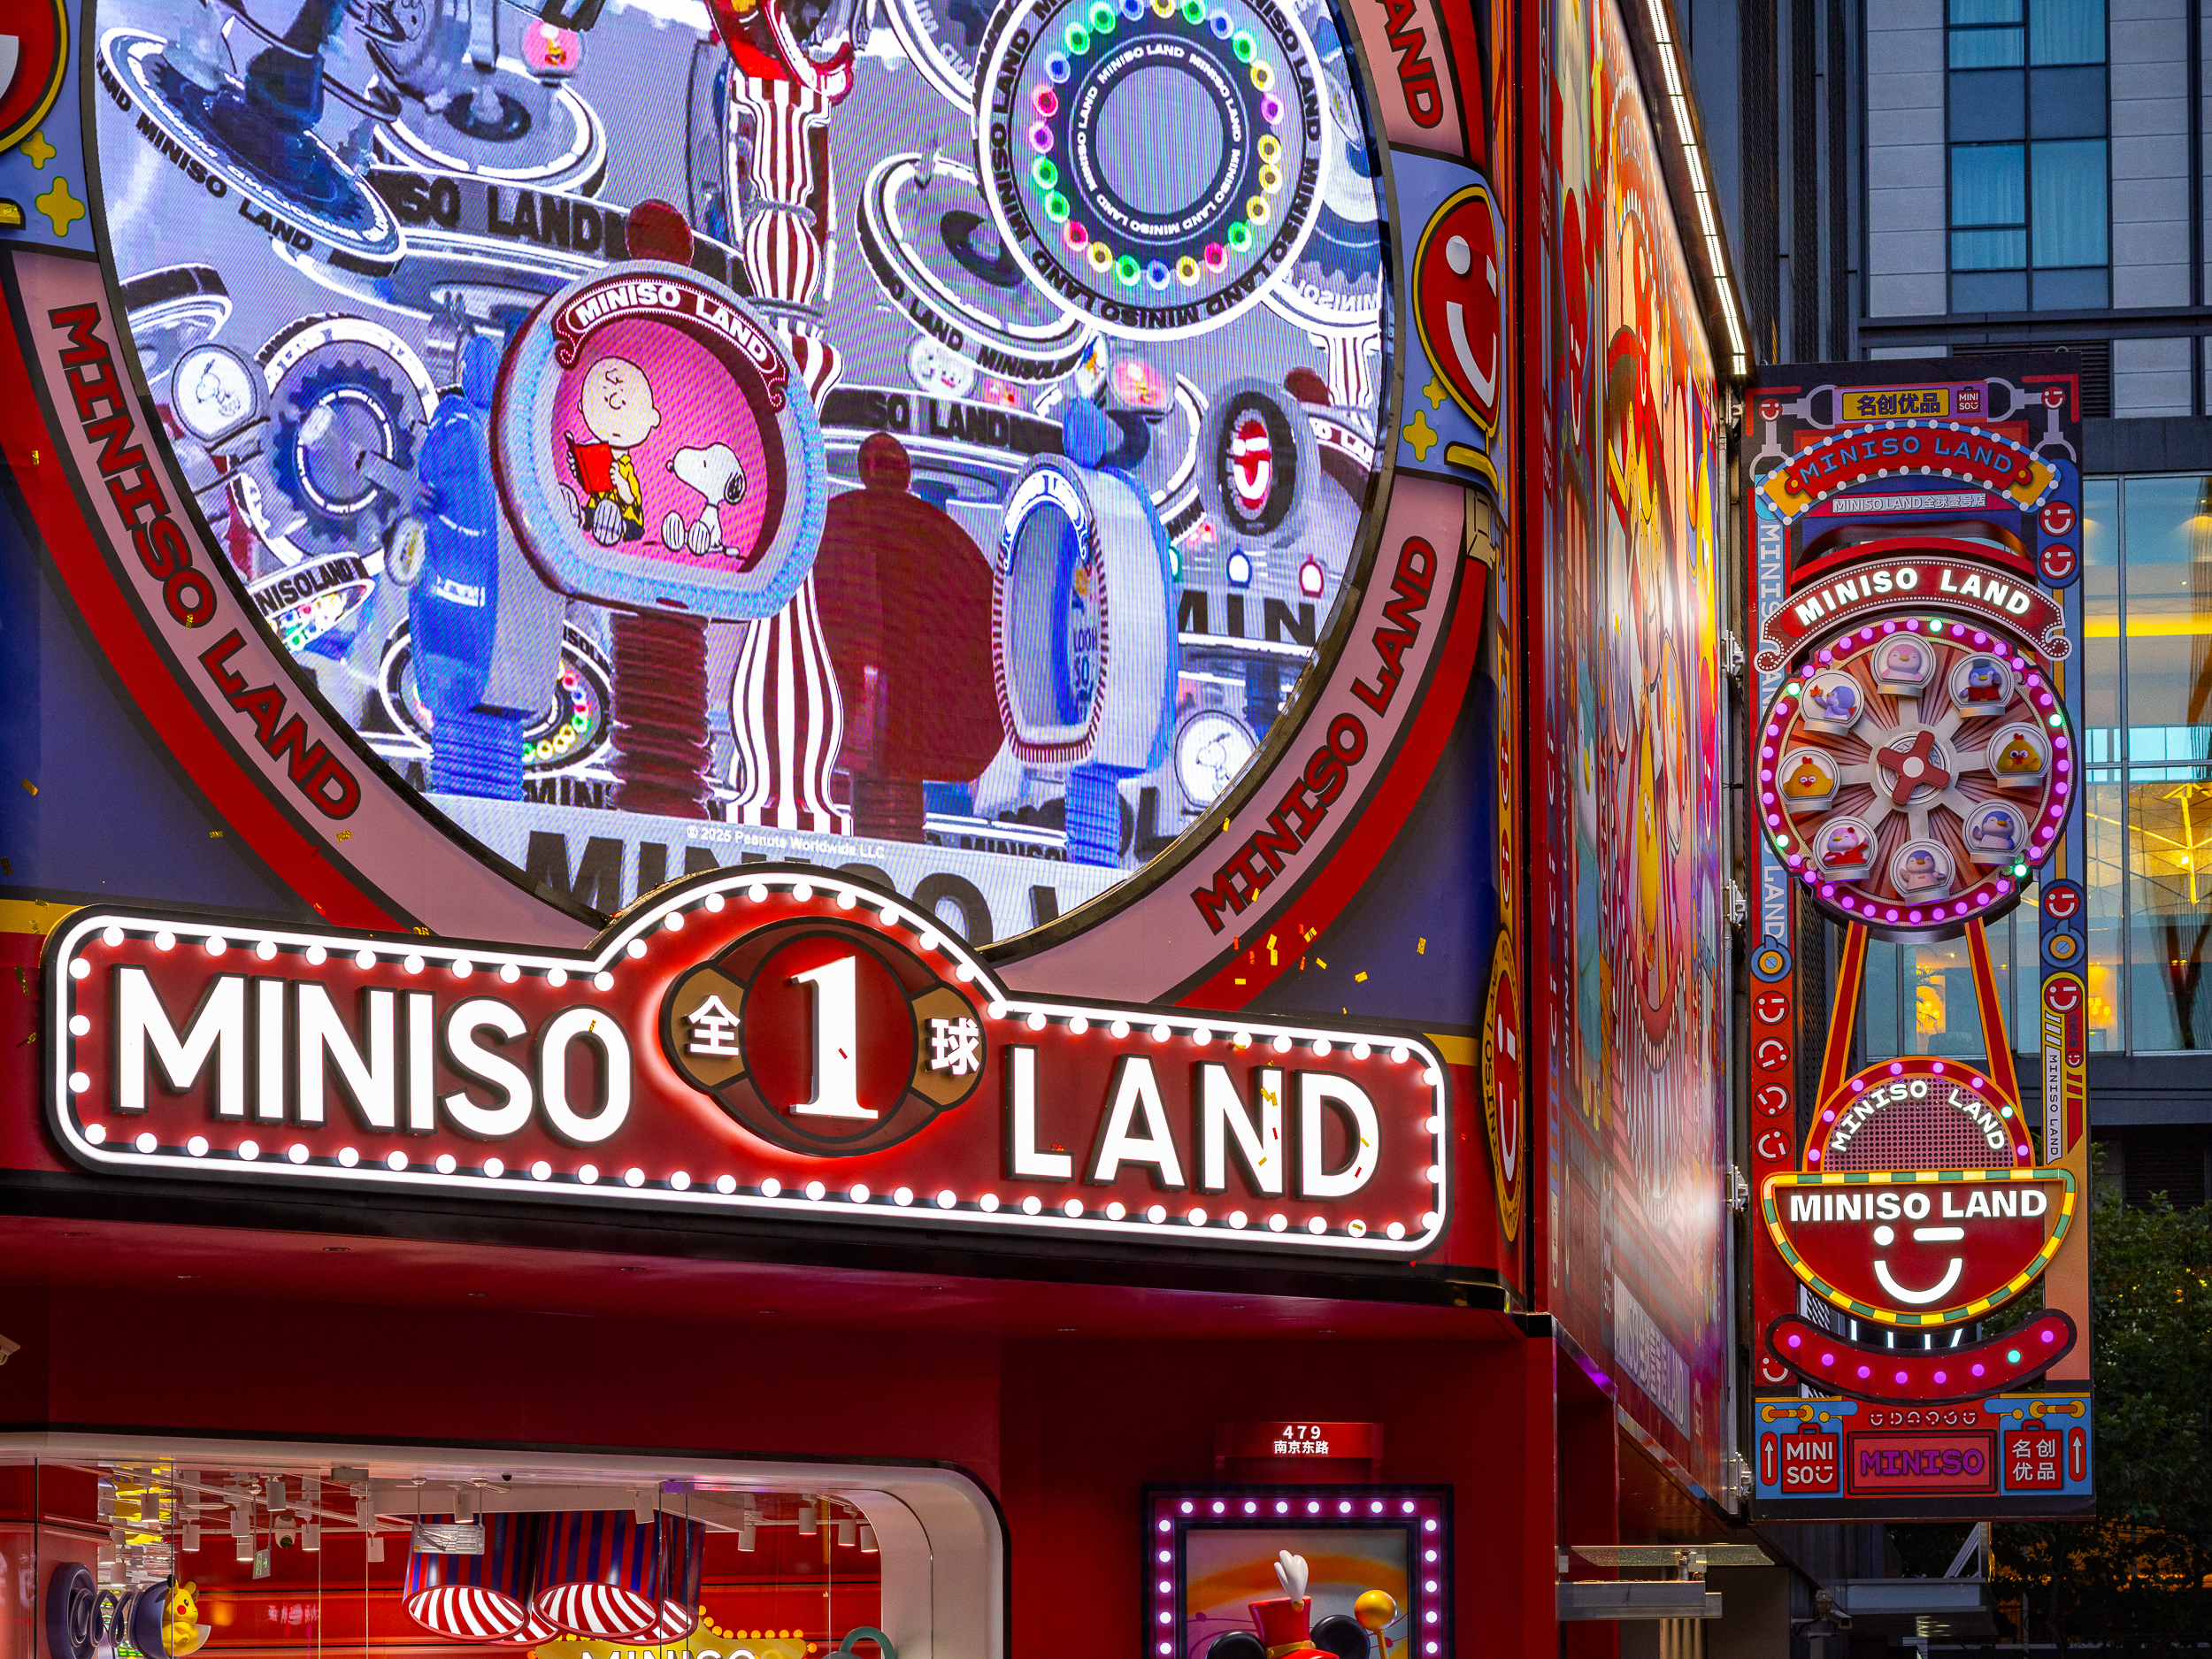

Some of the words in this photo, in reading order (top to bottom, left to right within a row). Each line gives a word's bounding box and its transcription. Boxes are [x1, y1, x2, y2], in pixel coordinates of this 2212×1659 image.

[993, 27, 1031, 114] LAND
[1097, 47, 1144, 84] MINISO
[1146, 44, 1185, 58] LAND
[1079, 86, 1098, 128] LAND
[1225, 98, 1241, 142] LAND
[135, 111, 227, 198] MINISO
[238, 197, 313, 251] LAND
[990, 122, 1032, 244] MINISO
[1096, 194, 1129, 226] LAND
[1182, 201, 1217, 230] LAND
[1268, 157, 1319, 259] MINISO
[1032, 250, 1097, 312] LAND
[1206, 258, 1271, 317] LAND
[576, 283, 681, 327] MINISO
[695, 295, 768, 362] LAND
[910, 298, 963, 351] LAND
[1101, 305, 1201, 328] MINISO
[1857, 393, 1941, 416] 名创优品
[1959, 393, 1978, 402] MINI
[1799, 435, 1922, 487] MINISO
[1934, 437, 2014, 475] LAND
[1834, 499, 1883, 512] MINISO
[1886, 497, 1923, 510] LAND
[1924, 493, 1986, 508] 全球壹号店
[47, 302, 219, 629] MINISO
[197, 626, 361, 821] LAND
[1760, 524, 1781, 618] MINIS
[1793, 566, 1919, 626] MINISO
[1940, 568, 2031, 615] LAND
[1190, 712, 1369, 936] MINISO
[1349, 534, 1440, 718] LAND
[701, 827, 732, 843] 2025
[735, 831, 787, 849] Peanuts
[790, 836, 856, 856] Worldwide
[859, 845, 885, 859] LLC
[1764, 865, 1785, 939] LAND
[115, 964, 634, 1148] MINISO
[686, 993, 742, 1056] 全
[790, 955, 879, 1121] 1
[927, 1017, 981, 1077] 球
[1007, 1044, 1381, 1200] LAND
[2049, 1055, 2058, 1113] MINISO
[1831, 1079, 1928, 1152] MINISO
[1948, 1088, 2005, 1151] LAND
[2049, 1118, 2059, 1156] LAND
[1790, 1192, 1931, 1222] MINISO
[1942, 1189, 2047, 1217] LAND
[1273, 1440, 1329, 1454] 南京东路
[1282, 1425, 1321, 1440] 479
[1786, 1441, 1833, 1461] MINI
[2011, 1439, 2056, 1458] 名创
[1861, 1448, 1985, 1476] MINISO
[2011, 1461, 2056, 1481] 优品
